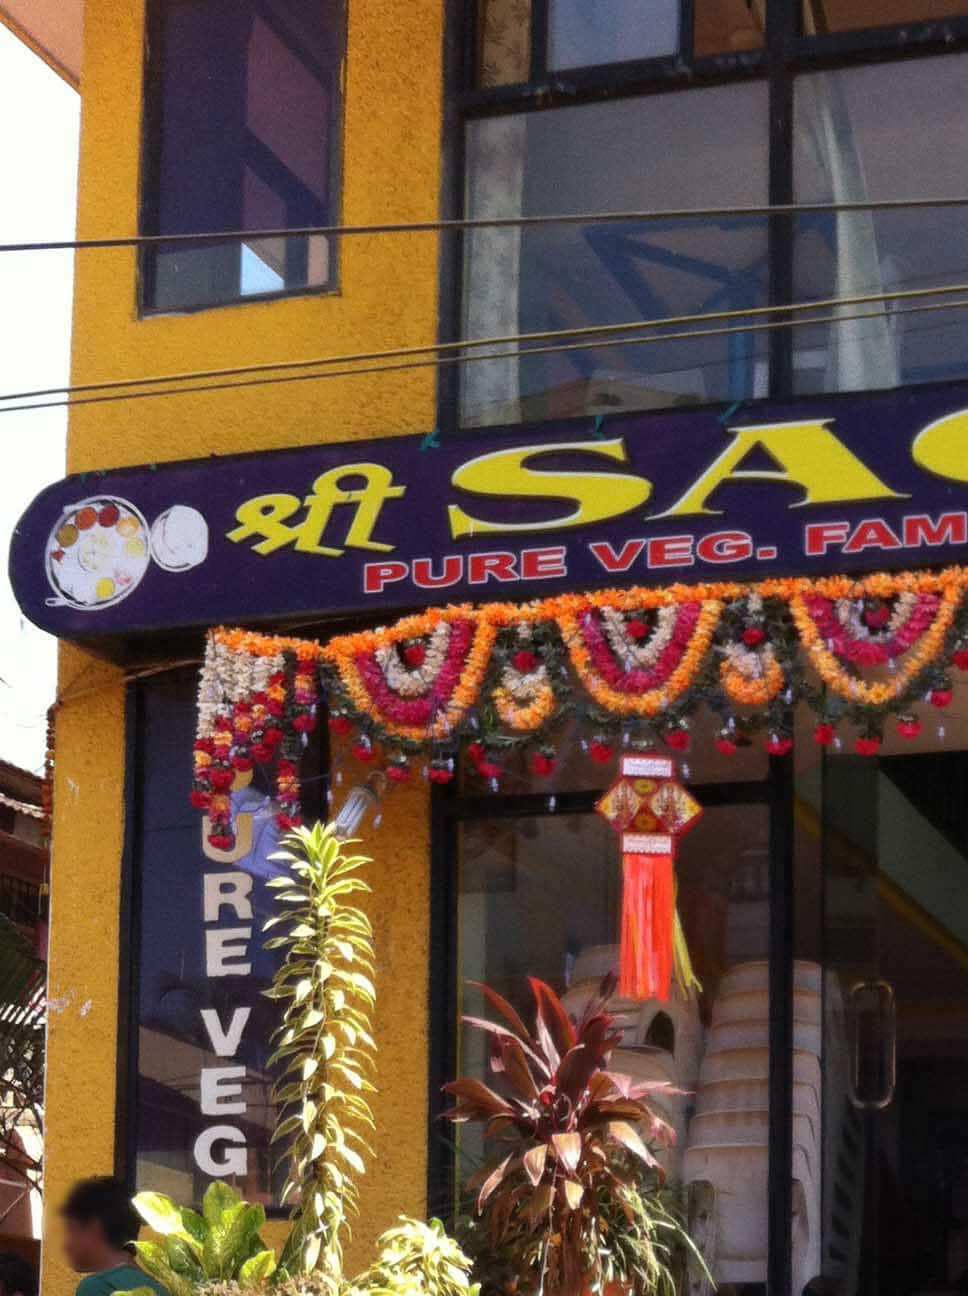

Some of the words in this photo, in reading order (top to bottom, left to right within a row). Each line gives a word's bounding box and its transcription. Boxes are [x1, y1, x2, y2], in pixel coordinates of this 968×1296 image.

[226, 463, 407, 556] श्री
[363, 546, 566, 593] PURE
[591, 532, 776, 571] VEG.
[202, 755, 255, 977] URE
[193, 1007, 252, 1178] VEG
